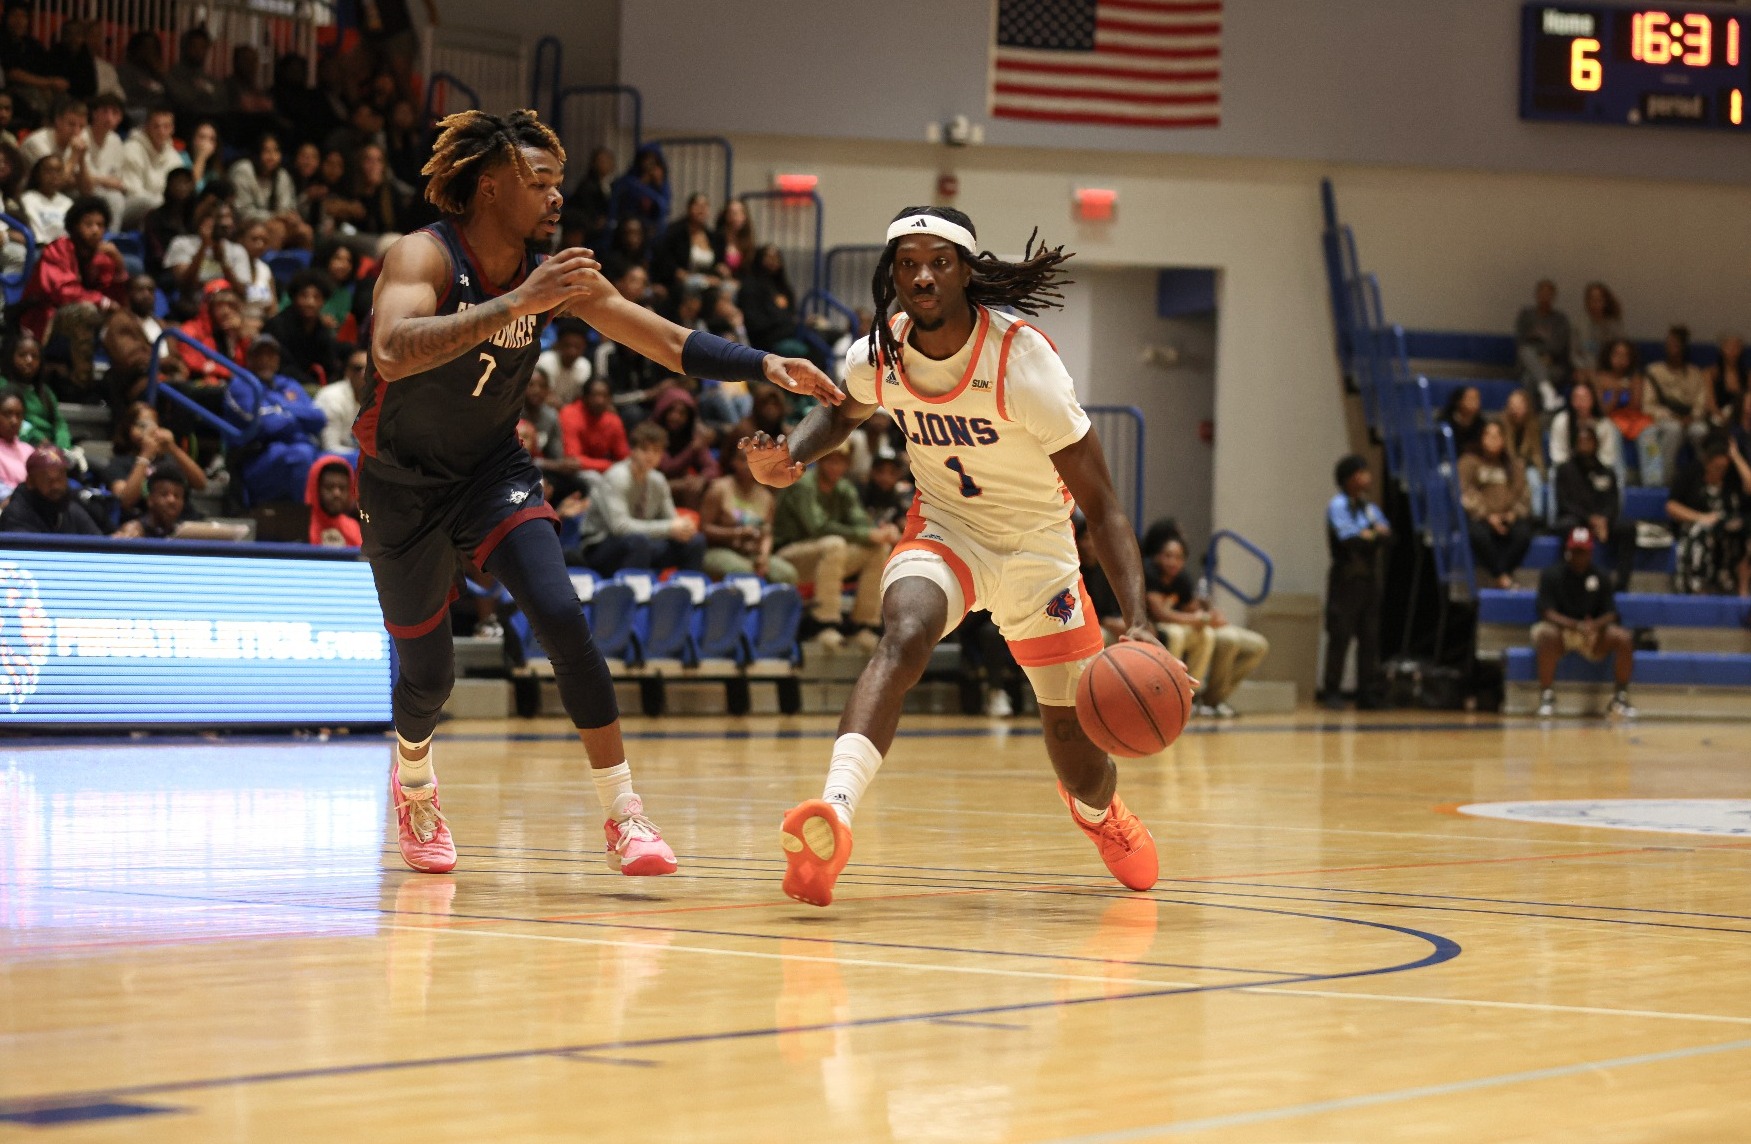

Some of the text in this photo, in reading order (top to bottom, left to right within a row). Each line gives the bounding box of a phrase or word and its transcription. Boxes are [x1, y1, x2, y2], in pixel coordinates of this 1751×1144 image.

[1632, 11, 1740, 66] 16:31
[1571, 38, 1602, 91] 6
[1730, 88, 1742, 125] 1
[472, 352, 497, 397] 7
[894, 408, 1000, 447] LIONS
[944, 455, 982, 498] 1
